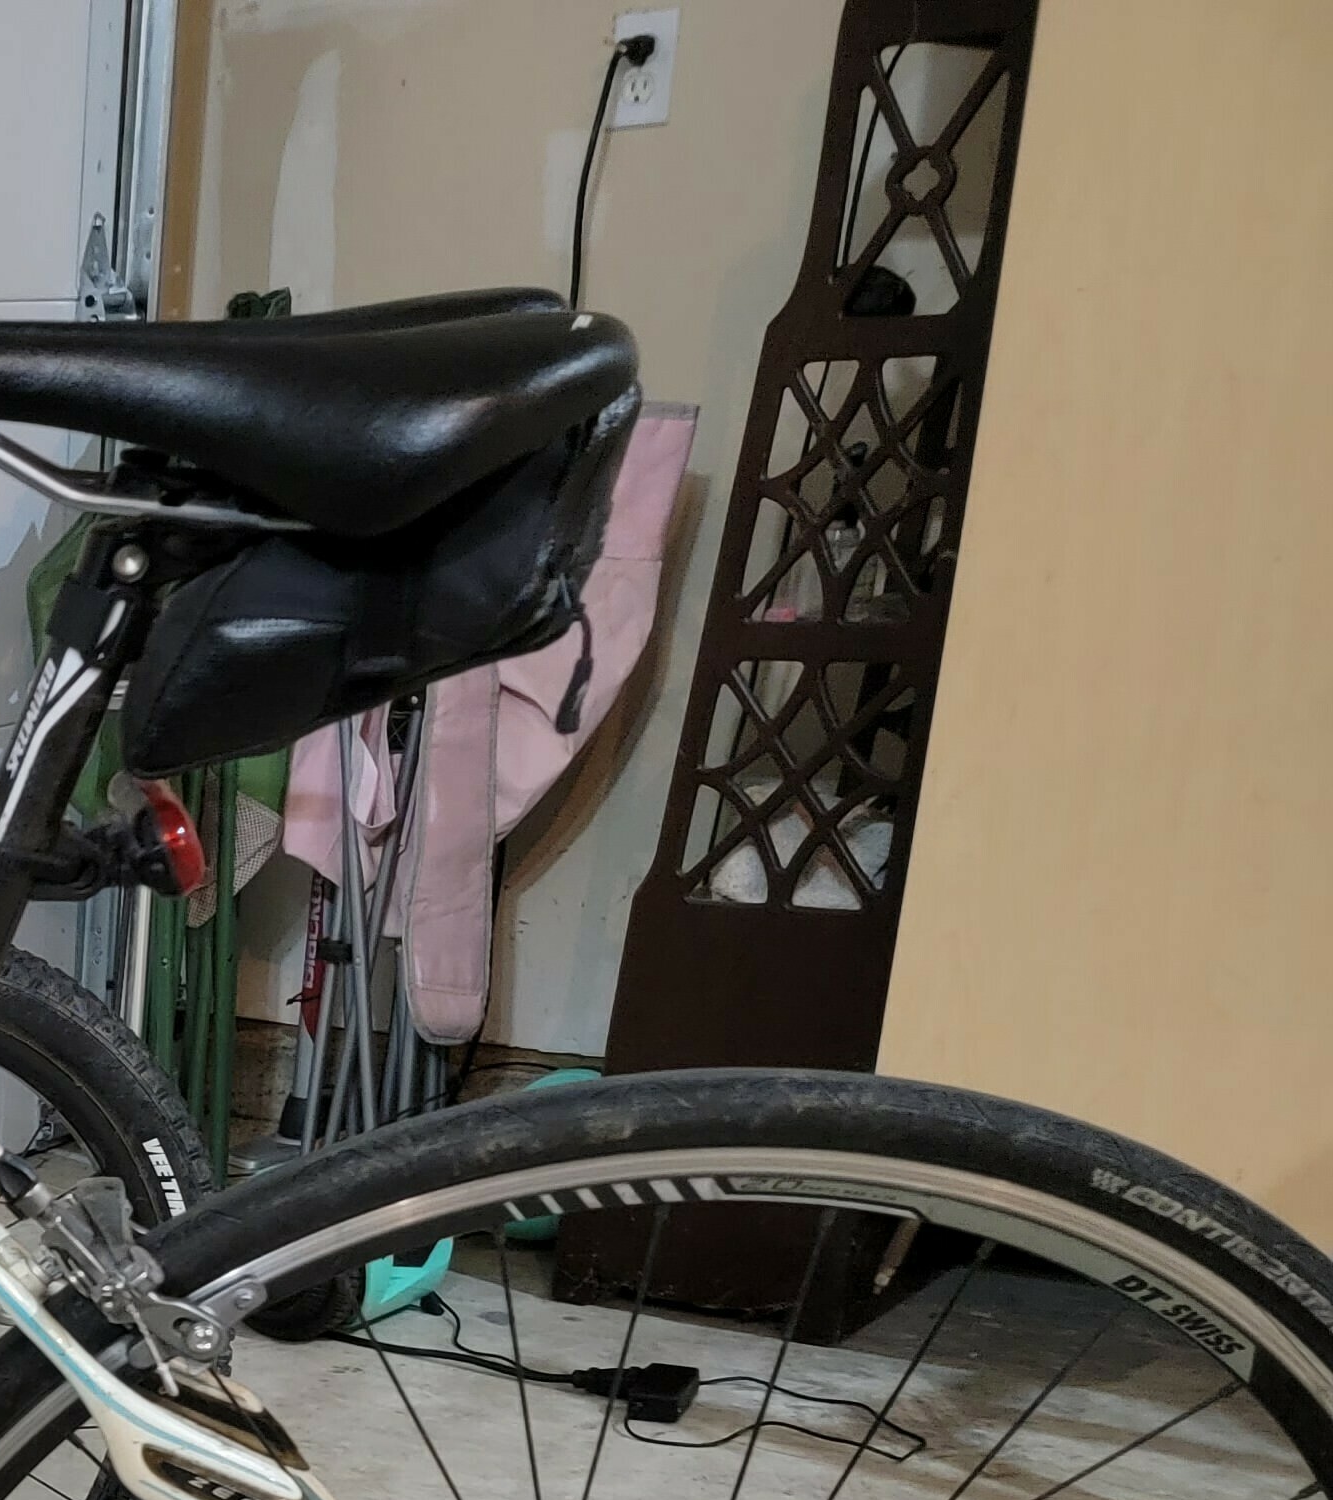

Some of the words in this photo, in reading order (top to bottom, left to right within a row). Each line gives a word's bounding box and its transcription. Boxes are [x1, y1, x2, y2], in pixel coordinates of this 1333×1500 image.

[142, 1138, 174, 1177] VEE
[1112, 1274, 1173, 1304] DT
[1156, 1303, 1246, 1356] SWISS
